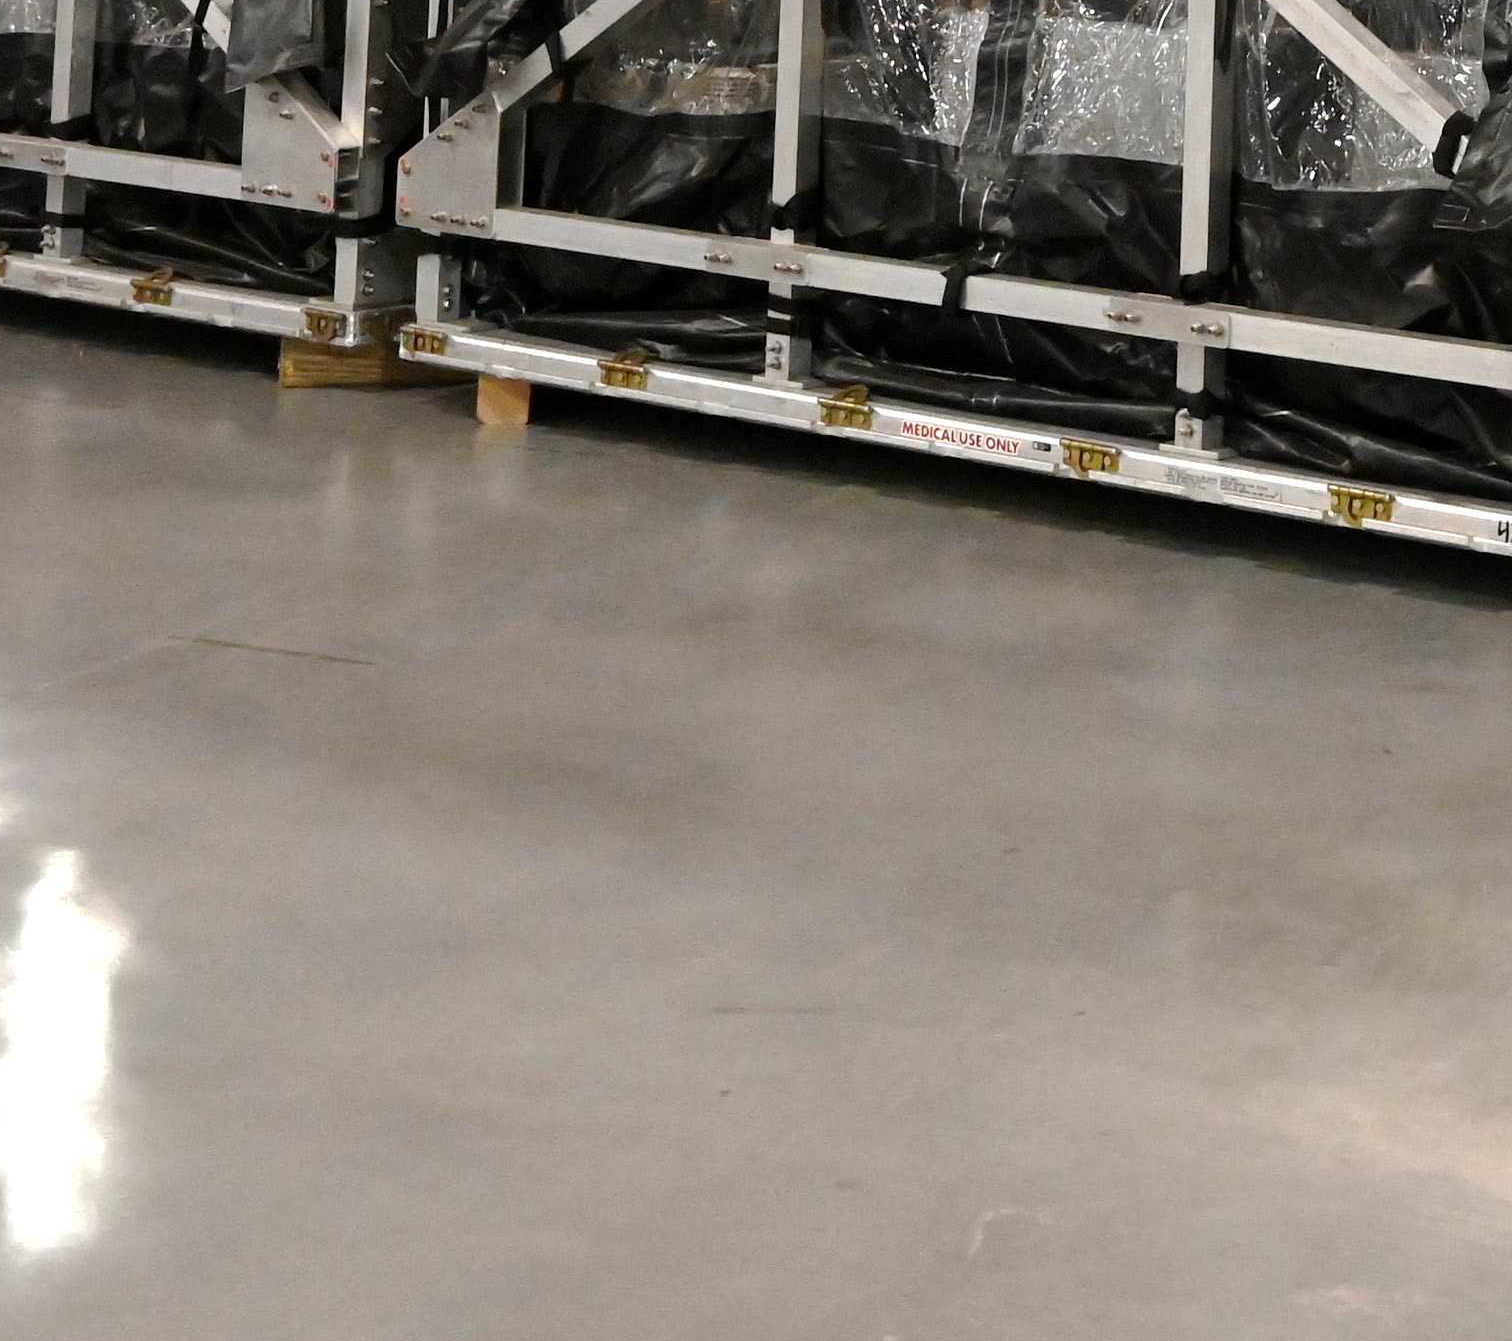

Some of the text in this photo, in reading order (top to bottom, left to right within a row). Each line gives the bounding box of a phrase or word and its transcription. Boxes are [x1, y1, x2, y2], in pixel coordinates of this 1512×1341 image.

[902, 421, 957, 443] MEDICAL
[959, 432, 982, 448] USE
[985, 436, 1020, 454] ONLY
